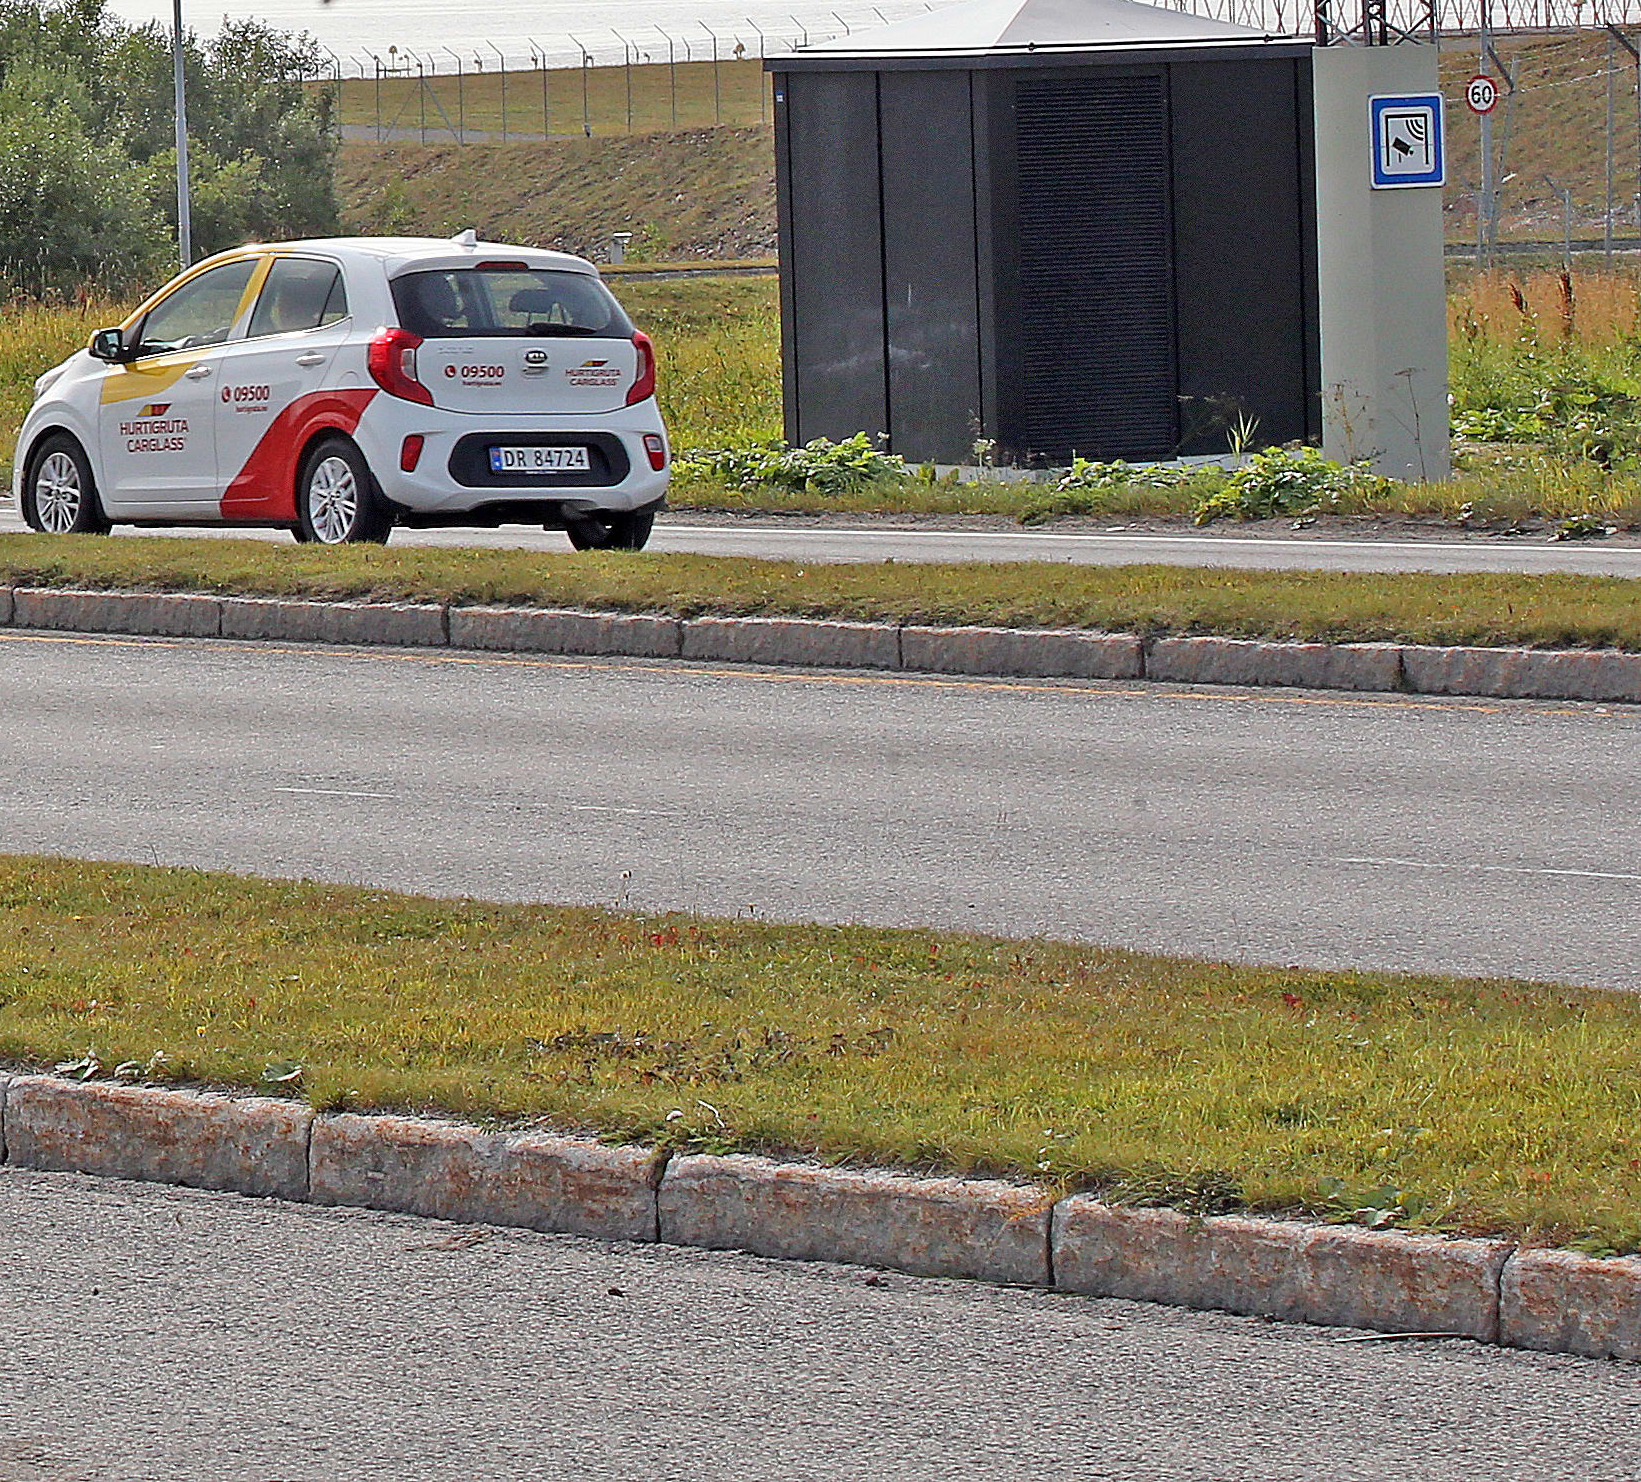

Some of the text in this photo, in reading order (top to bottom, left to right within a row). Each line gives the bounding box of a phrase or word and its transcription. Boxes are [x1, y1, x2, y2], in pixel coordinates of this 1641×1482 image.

[1471, 85, 1492, 104] 60
[461, 365, 505, 378] 09500
[565, 369, 621, 377] HURTIGRUTA
[569, 378, 618, 386] CARGLASS
[234, 385, 270, 402] 09500
[119, 419, 190, 435] HURTIGRUTA
[127, 437, 185, 453] CARGLASS
[504, 449, 585, 467] DR 84724
